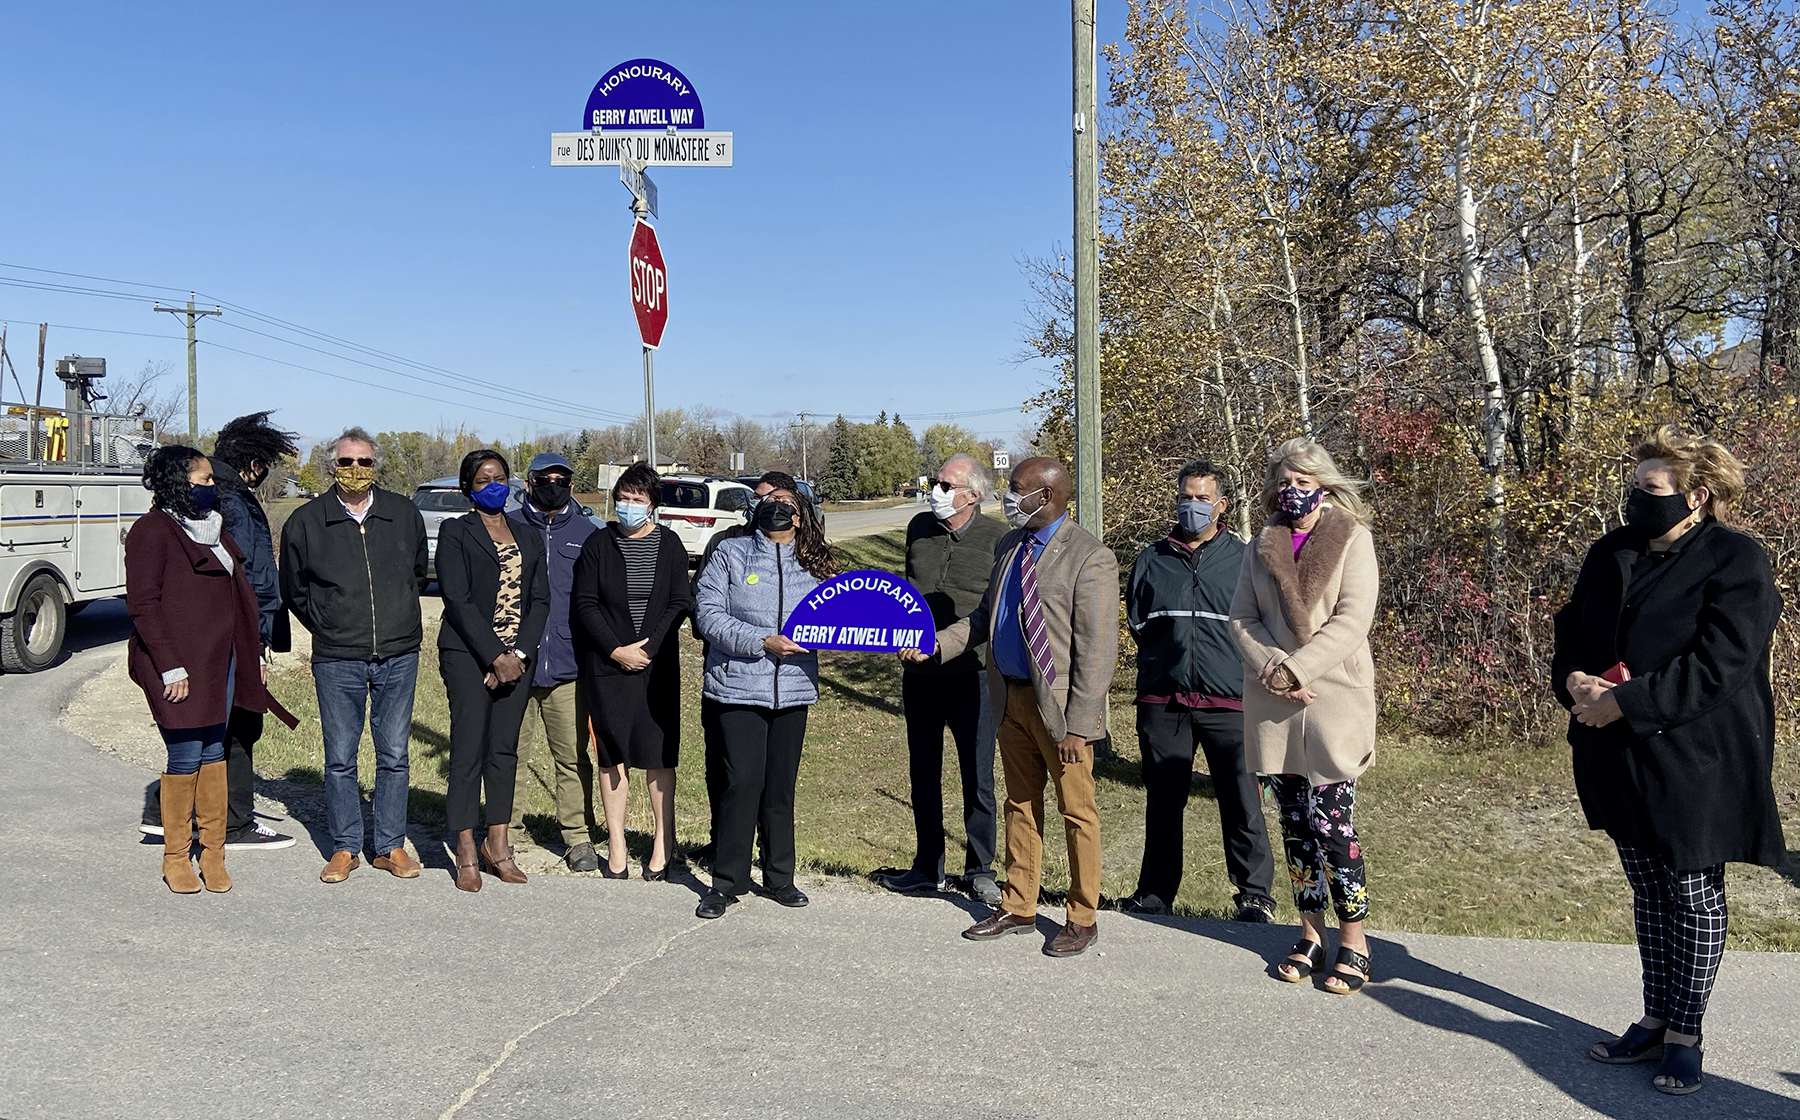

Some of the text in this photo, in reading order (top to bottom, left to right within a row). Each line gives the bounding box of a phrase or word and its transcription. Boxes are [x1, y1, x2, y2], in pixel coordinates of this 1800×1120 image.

[599, 65, 690, 97] HONOURARY
[592, 108, 694, 125] GERRY ATWELL WAY
[557, 146, 571, 156] rue
[577, 138, 595, 161] DES
[637, 138, 650, 161] DU
[654, 138, 710, 161] MONASTERE
[716, 143, 726, 156] ST
[632, 256, 665, 312] STOP
[996, 456, 1007, 466] 50
[808, 577, 922, 615] HONOURARY
[792, 624, 924, 648] GERRY ATWELL WAY
